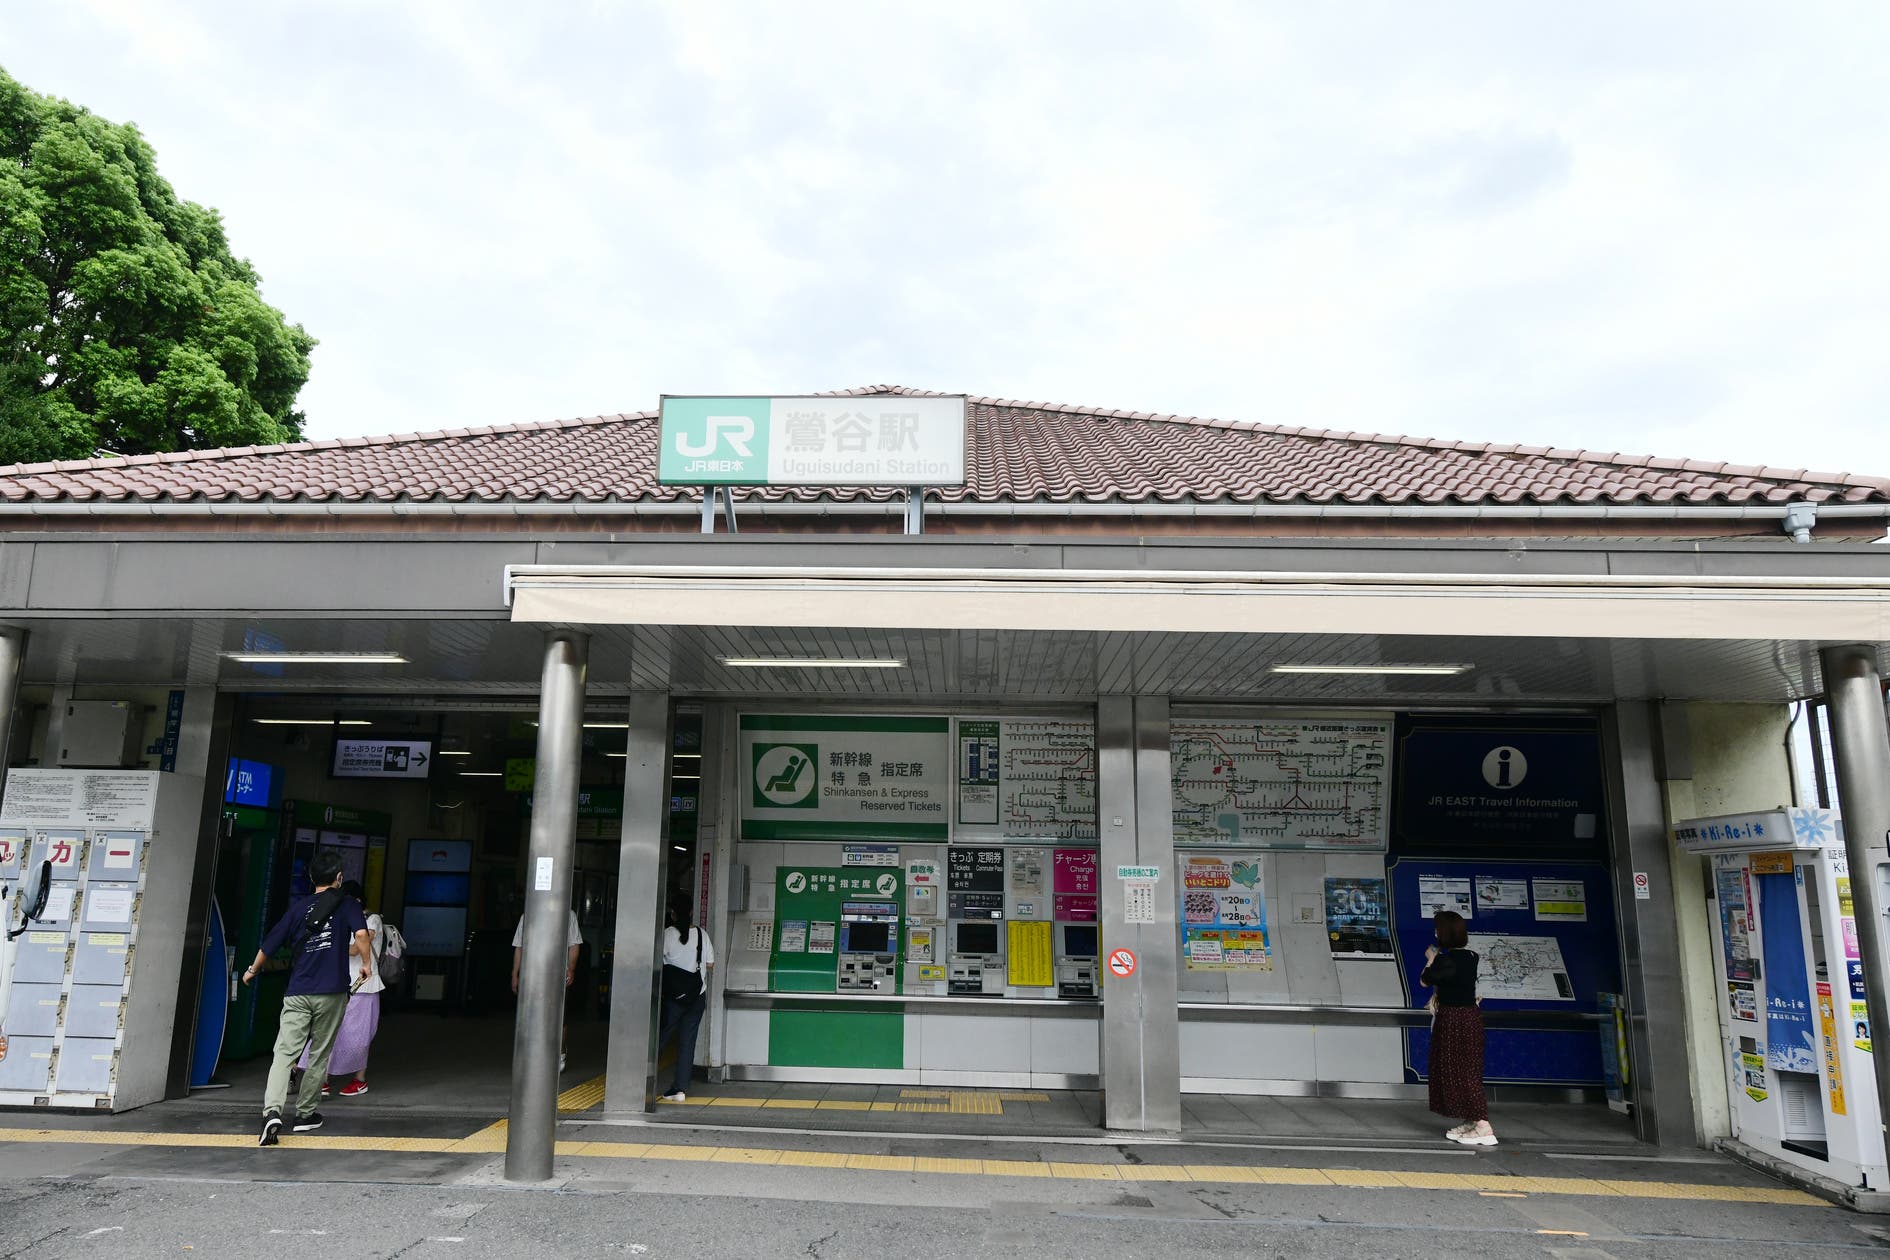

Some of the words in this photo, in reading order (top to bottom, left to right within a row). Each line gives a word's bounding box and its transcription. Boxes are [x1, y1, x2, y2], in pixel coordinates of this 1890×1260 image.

[675, 415, 755, 458] JR
[784, 411, 920, 453] 鶯谷駅
[684, 459, 745, 473] JR東日本
[783, 458, 881, 476] Uguisudani
[884, 458, 950, 475] Station
[830, 752, 872, 767] 新幹線
[880, 762, 923, 777] 指定席
[831, 771, 871, 786] 特急
[824, 787, 878, 798] Shinkansen
[881, 787, 888, 798] &
[891, 788, 929, 799] Express
[860, 801, 905, 811] Reserved
[907, 801, 942, 811] Tickets
[1428, 796, 1443, 806] JR
[1446, 796, 1476, 806] EAST
[1479, 797, 1513, 807] Travel
[1516, 797, 1579, 808] Information
[950, 851, 974, 863] きっぷ
[977, 852, 1002, 864] 定期券
[1070, 865, 1094, 874] Charge
[840, 879, 871, 889] 指定席
